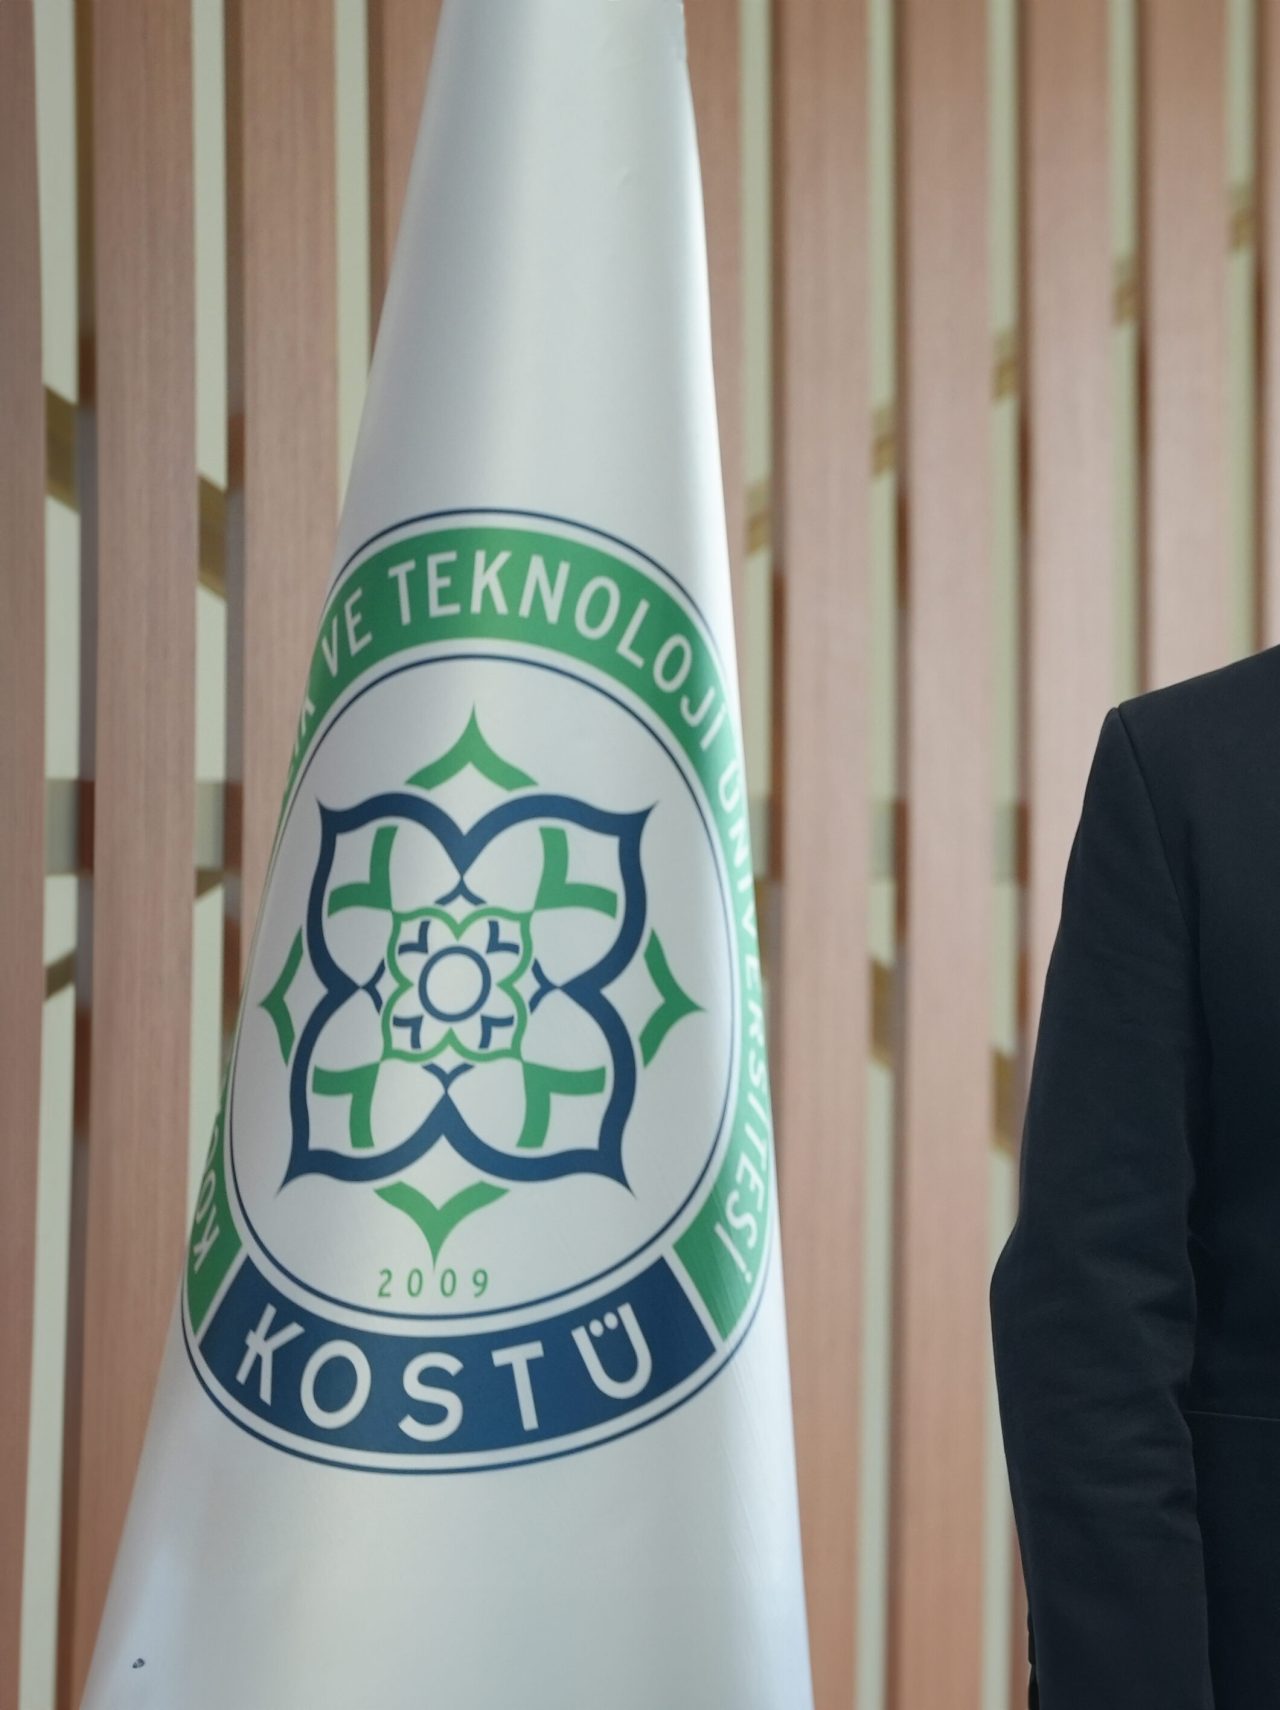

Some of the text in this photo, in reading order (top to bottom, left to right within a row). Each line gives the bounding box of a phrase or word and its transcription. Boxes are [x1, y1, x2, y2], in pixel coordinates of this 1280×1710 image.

[321, 587, 373, 678] VE
[377, 1267, 489, 1298] 2009
[235, 1302, 653, 1442] KOSTÜ
